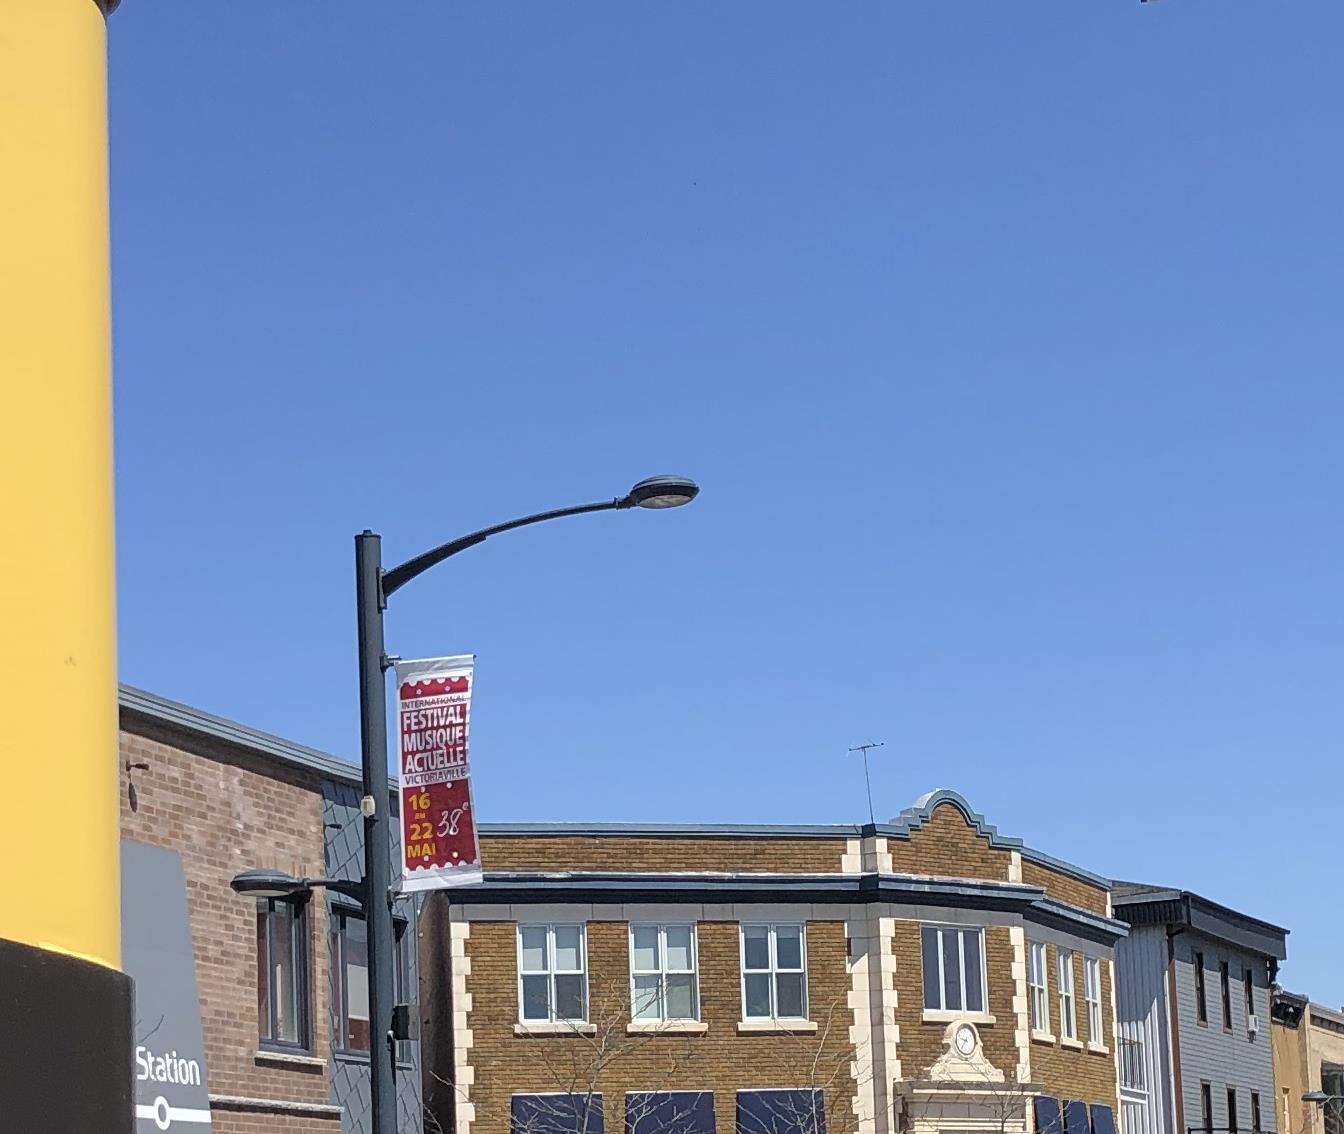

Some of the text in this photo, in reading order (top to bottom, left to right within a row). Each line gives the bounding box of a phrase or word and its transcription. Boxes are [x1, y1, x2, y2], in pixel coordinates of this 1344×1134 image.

[402, 695, 466, 709] INTERNATIONAL
[403, 706, 464, 731] FESTIVAL
[404, 726, 464, 752] MUSIQUE
[405, 748, 465, 773] ACTUELLE
[405, 768, 467, 785] VICTORIAVILLE
[408, 792, 431, 810] 16
[410, 823, 433, 841] 22
[407, 843, 436, 859] MAI
[136, 1046, 201, 1086] Station
